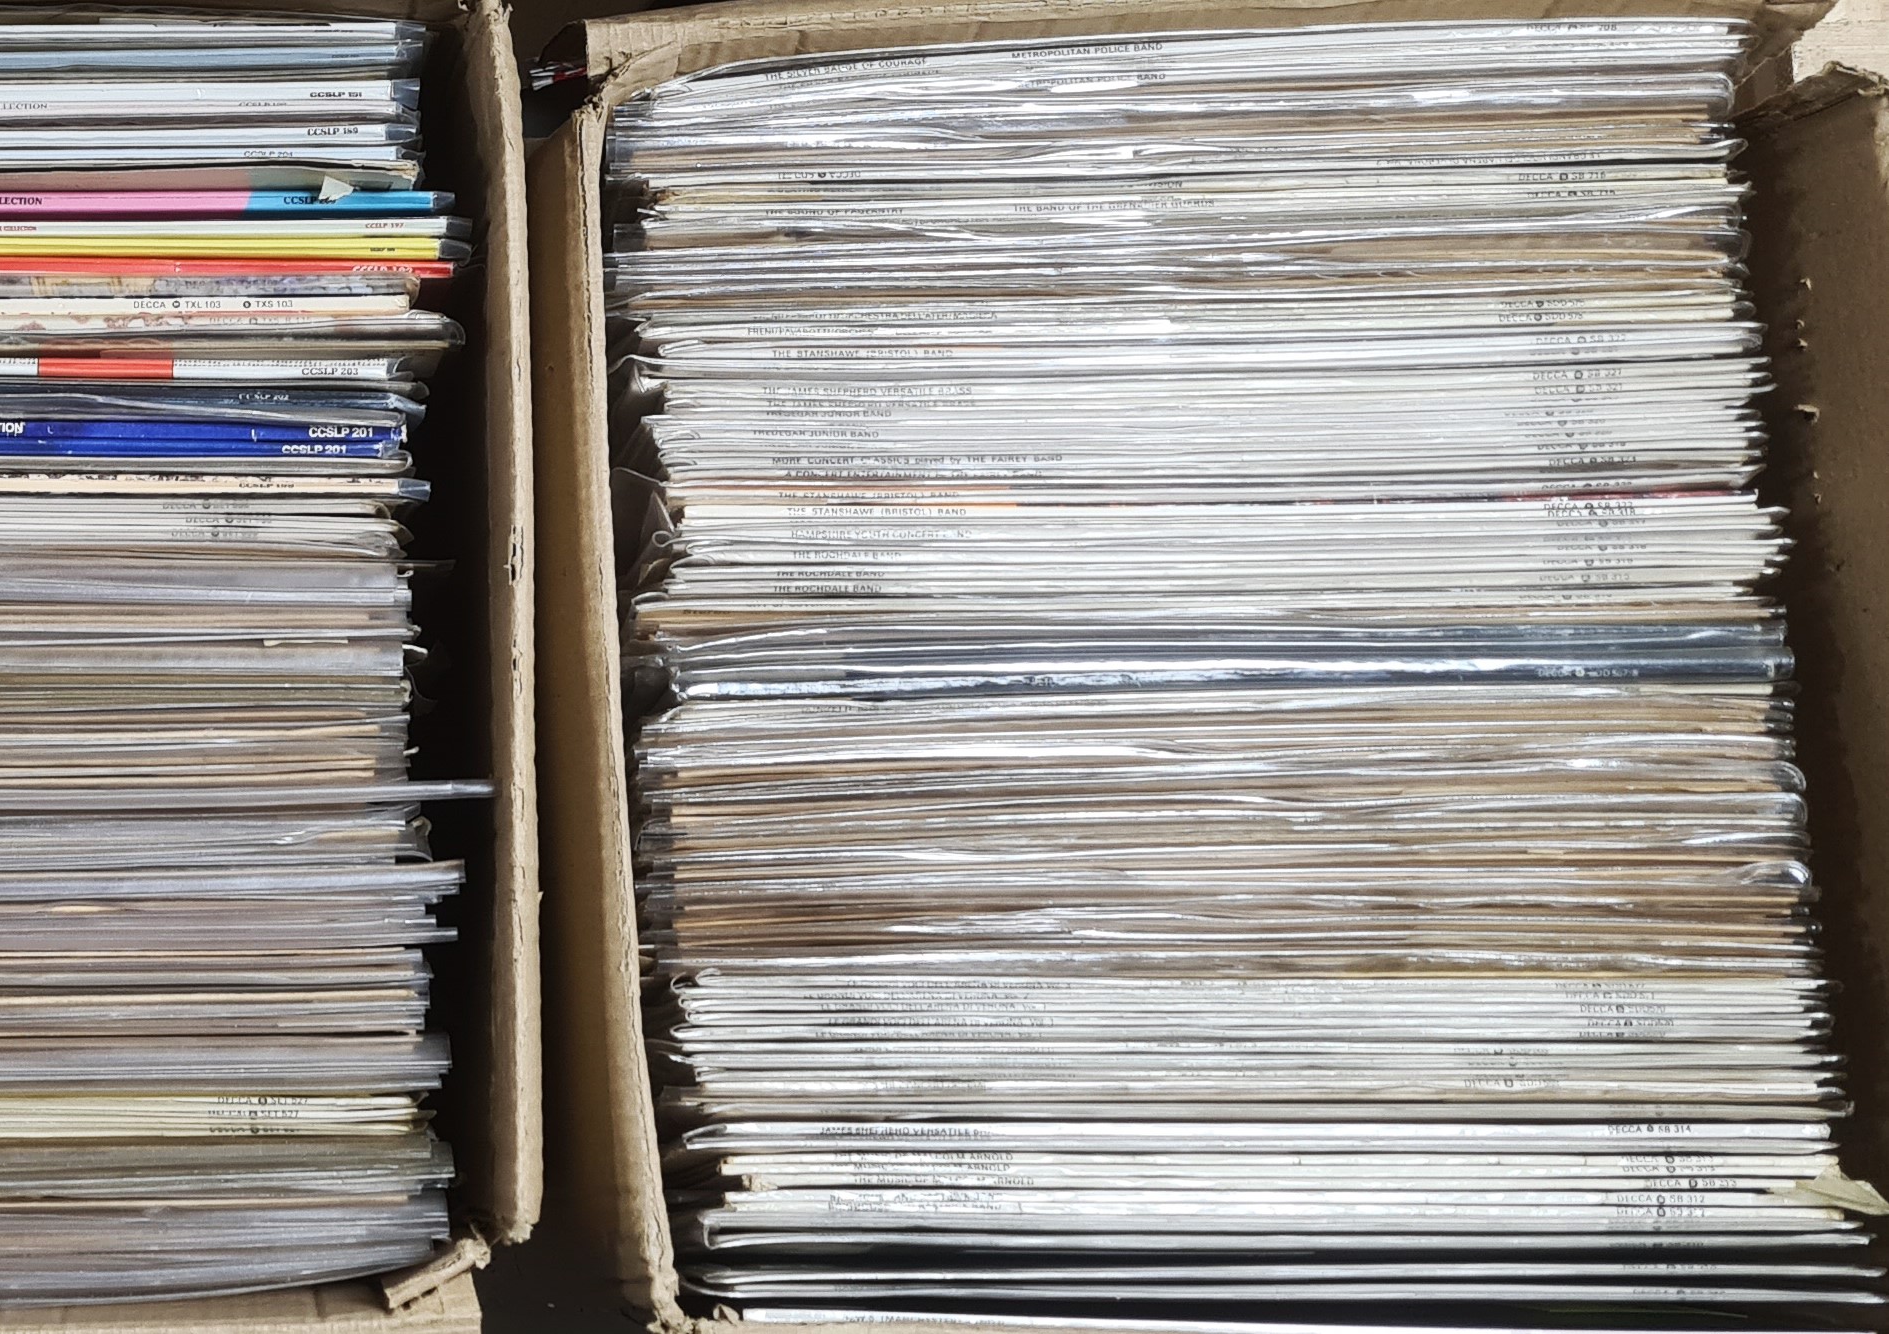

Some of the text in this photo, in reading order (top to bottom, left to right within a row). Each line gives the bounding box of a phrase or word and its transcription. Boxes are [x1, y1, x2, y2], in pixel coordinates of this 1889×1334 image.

[309, 427, 373, 438] CCSLP 201
[282, 445, 346, 454] CCSLP 201
